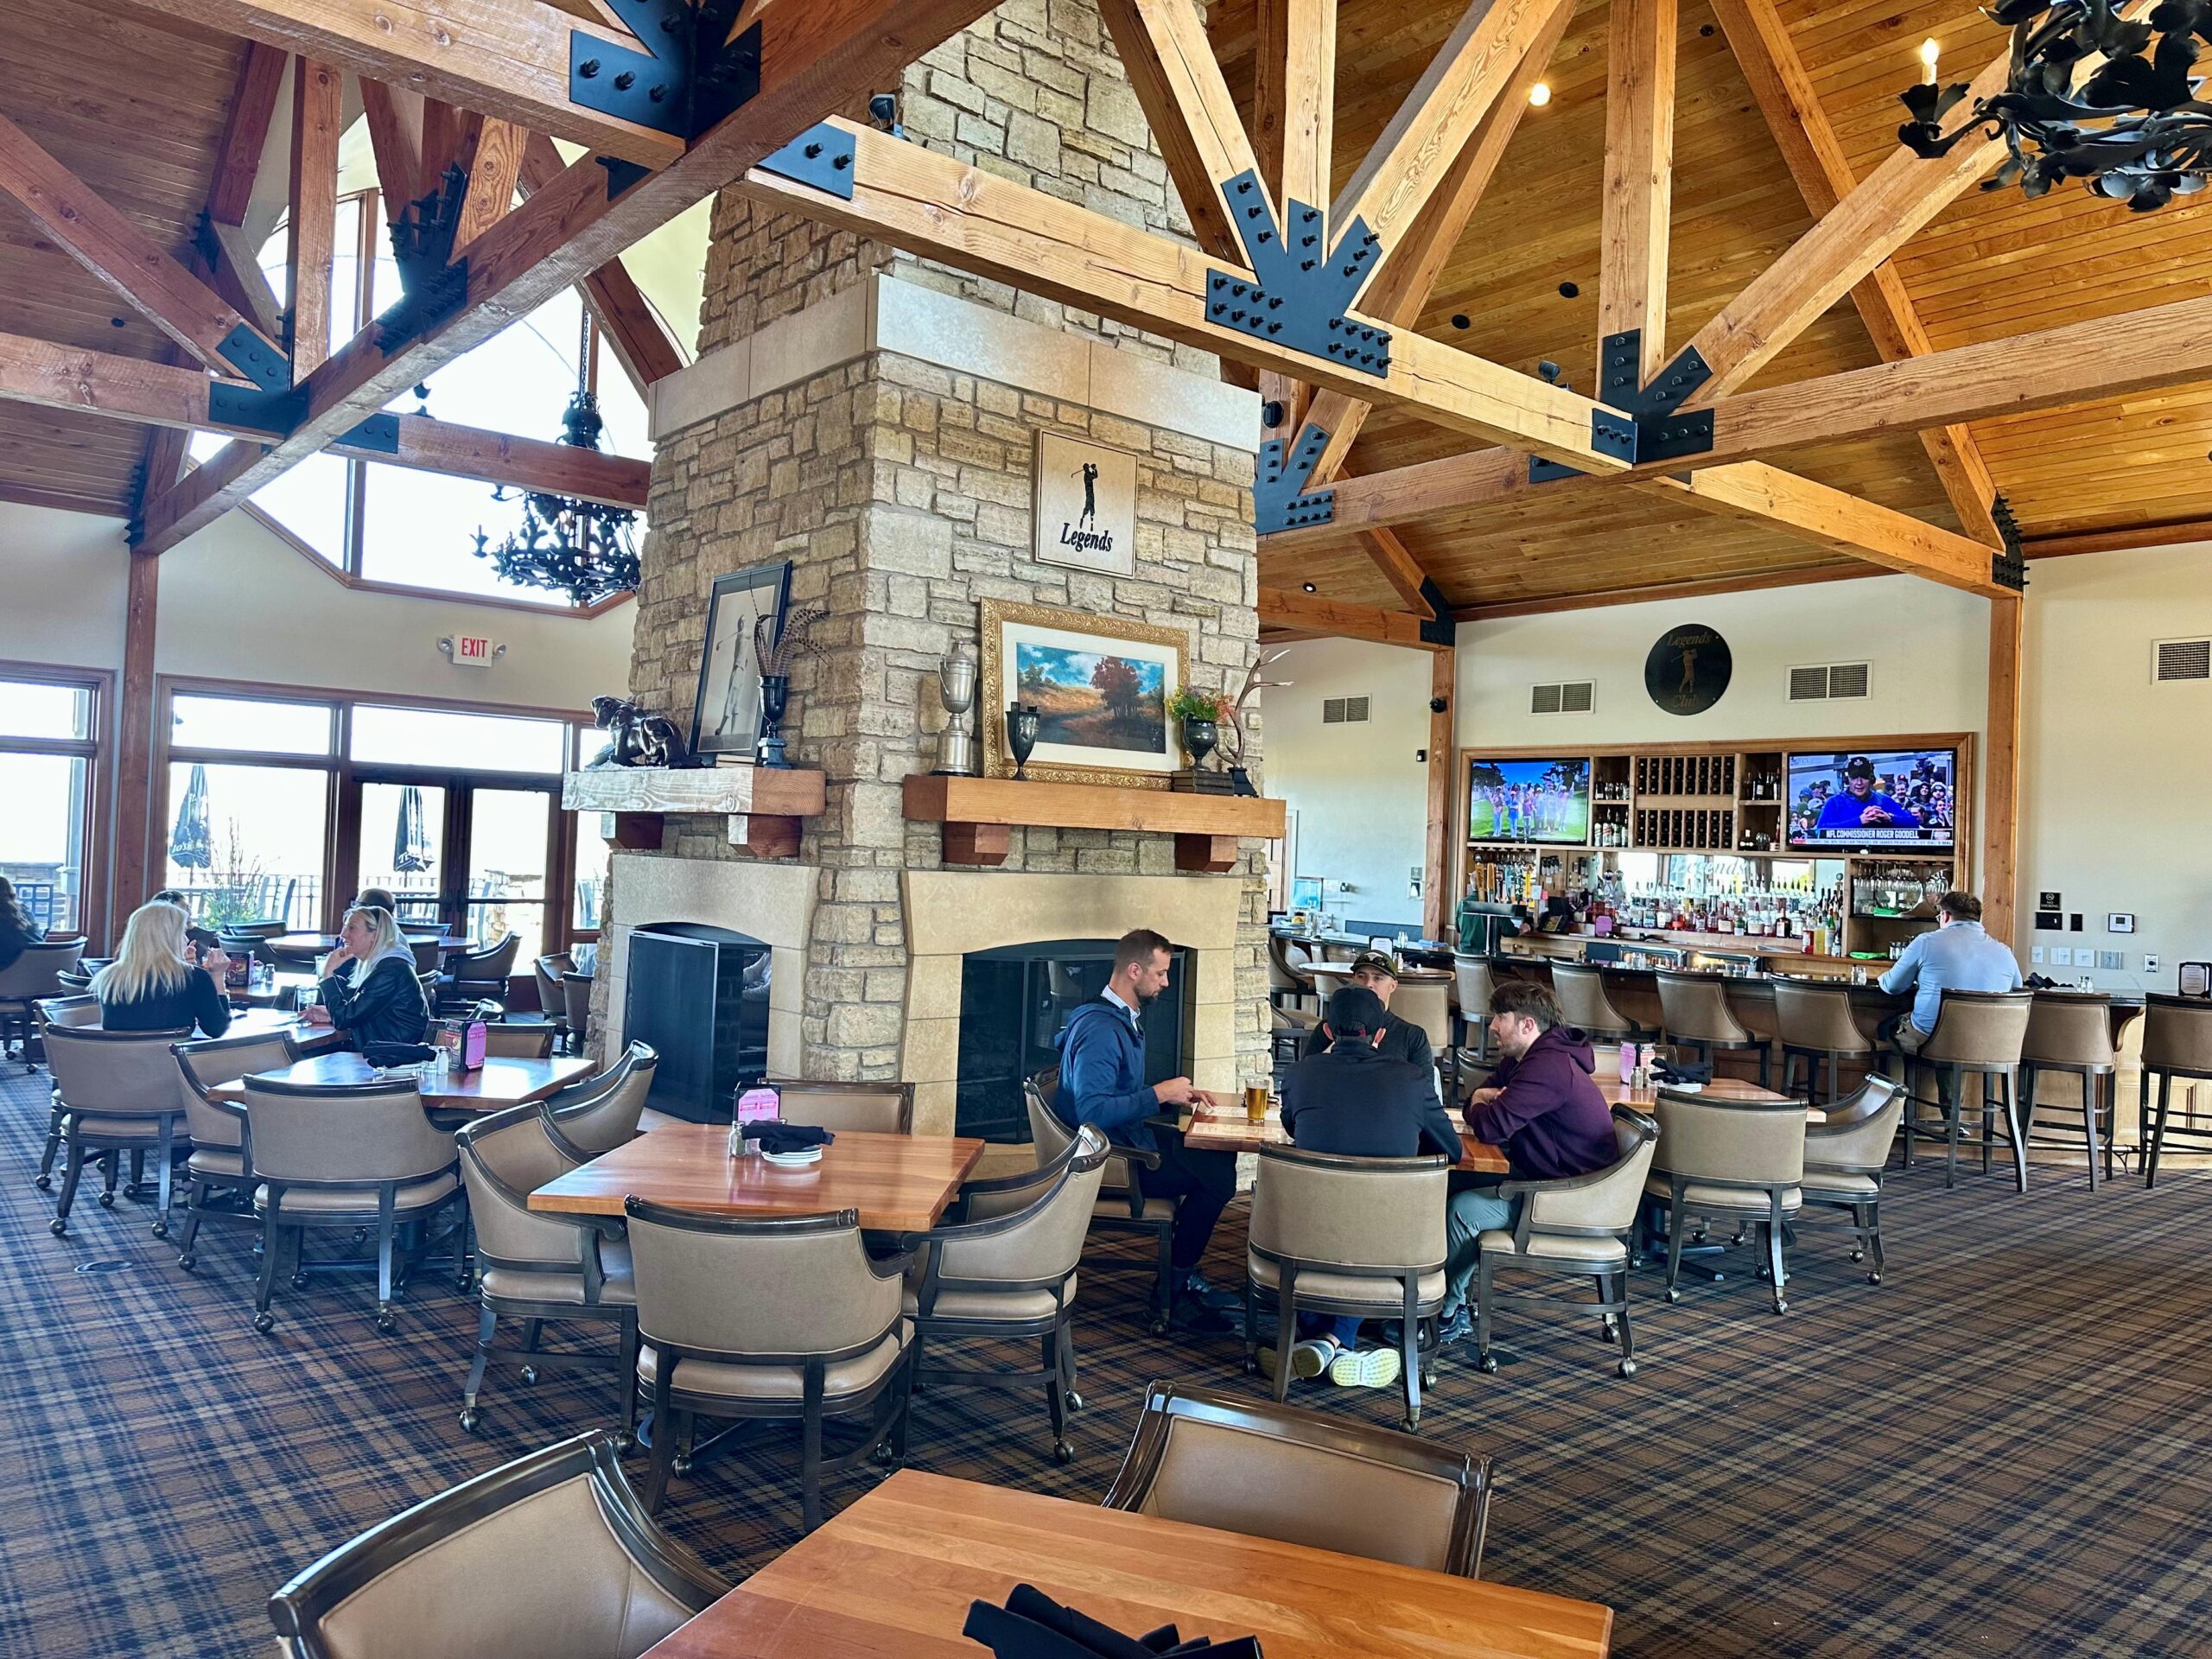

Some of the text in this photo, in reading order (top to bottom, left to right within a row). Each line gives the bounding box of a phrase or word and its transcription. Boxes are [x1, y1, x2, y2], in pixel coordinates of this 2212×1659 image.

[1060, 522, 1113, 552] Legends
[461, 637, 488, 658] EXIT
[1667, 631, 1712, 648] Legends
[1826, 830, 1919, 839] NFL COMMISSIONER ROGER GOODELL
